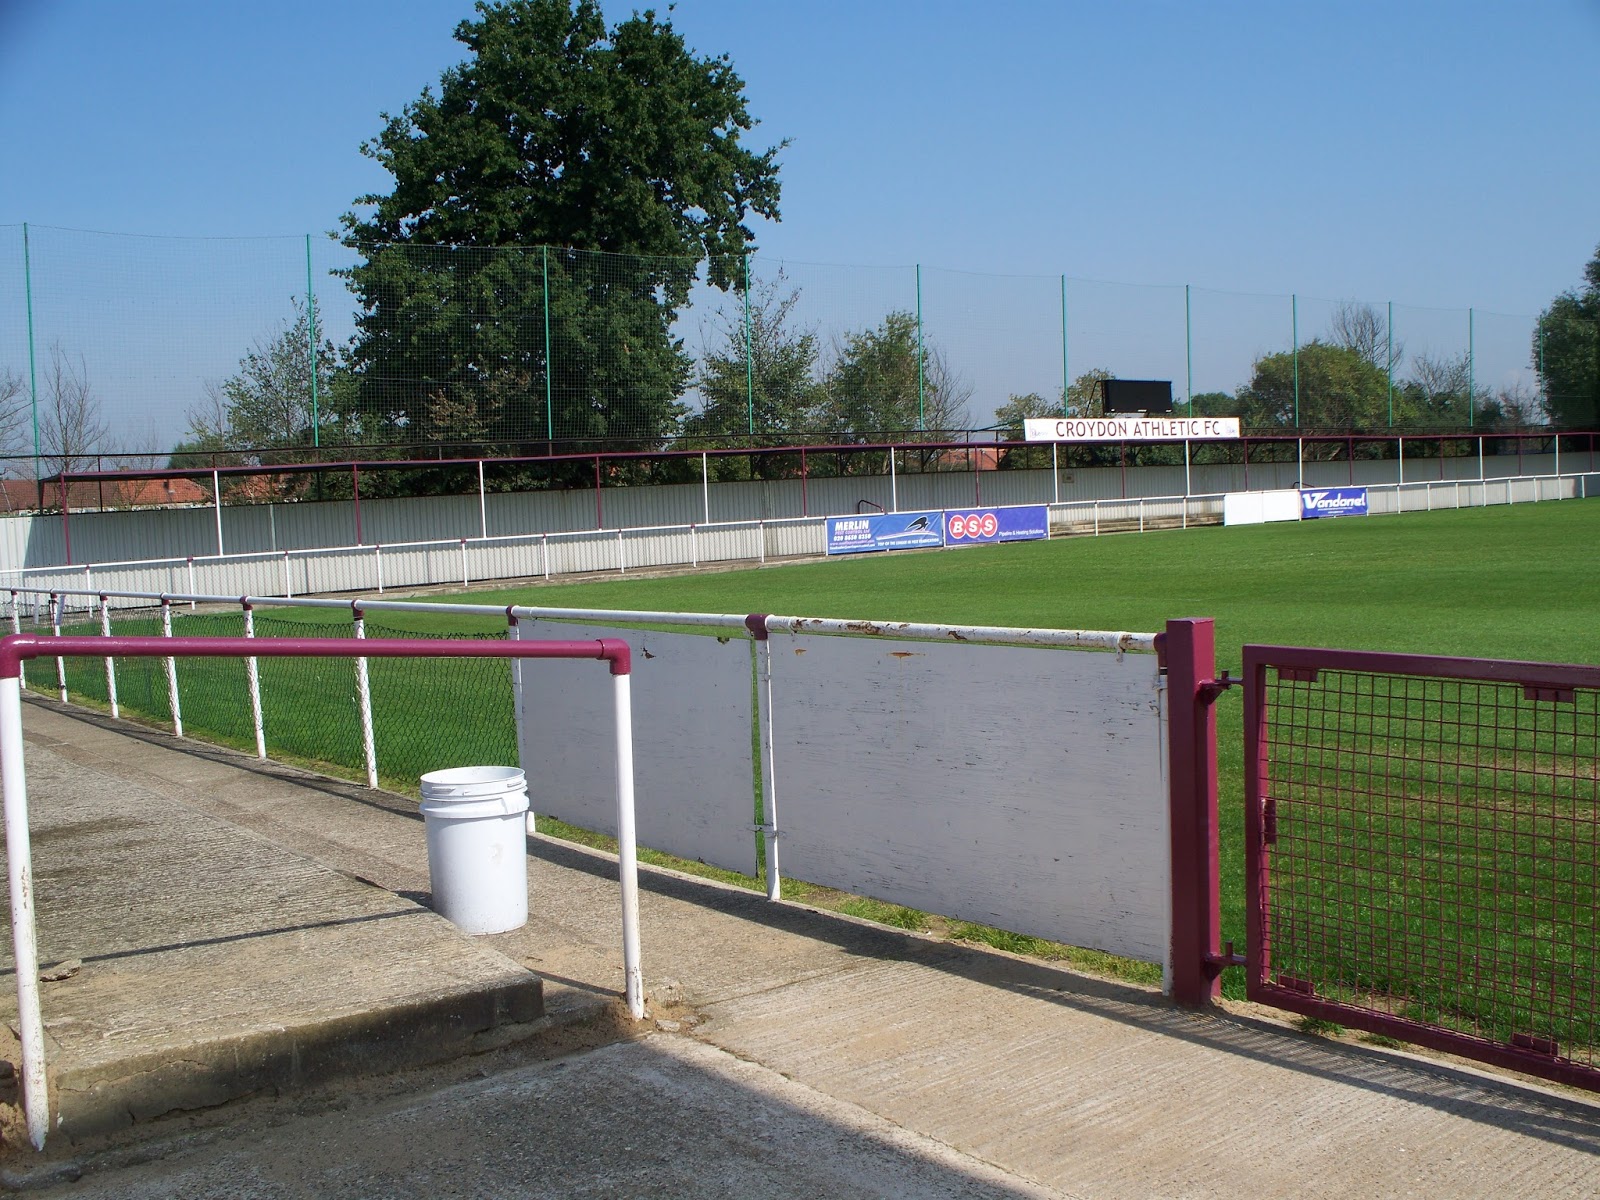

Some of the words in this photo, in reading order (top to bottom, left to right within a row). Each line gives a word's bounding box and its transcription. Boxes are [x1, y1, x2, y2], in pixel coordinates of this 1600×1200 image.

[1055, 421, 1128, 438] CROYDON
[1133, 420, 1199, 437] ATHLETIC
[1204, 420, 1221, 435] FC
[1302, 491, 1366, 509] Vandanel
[835, 520, 869, 530] MERLIN
[952, 519, 993, 533] BSS
